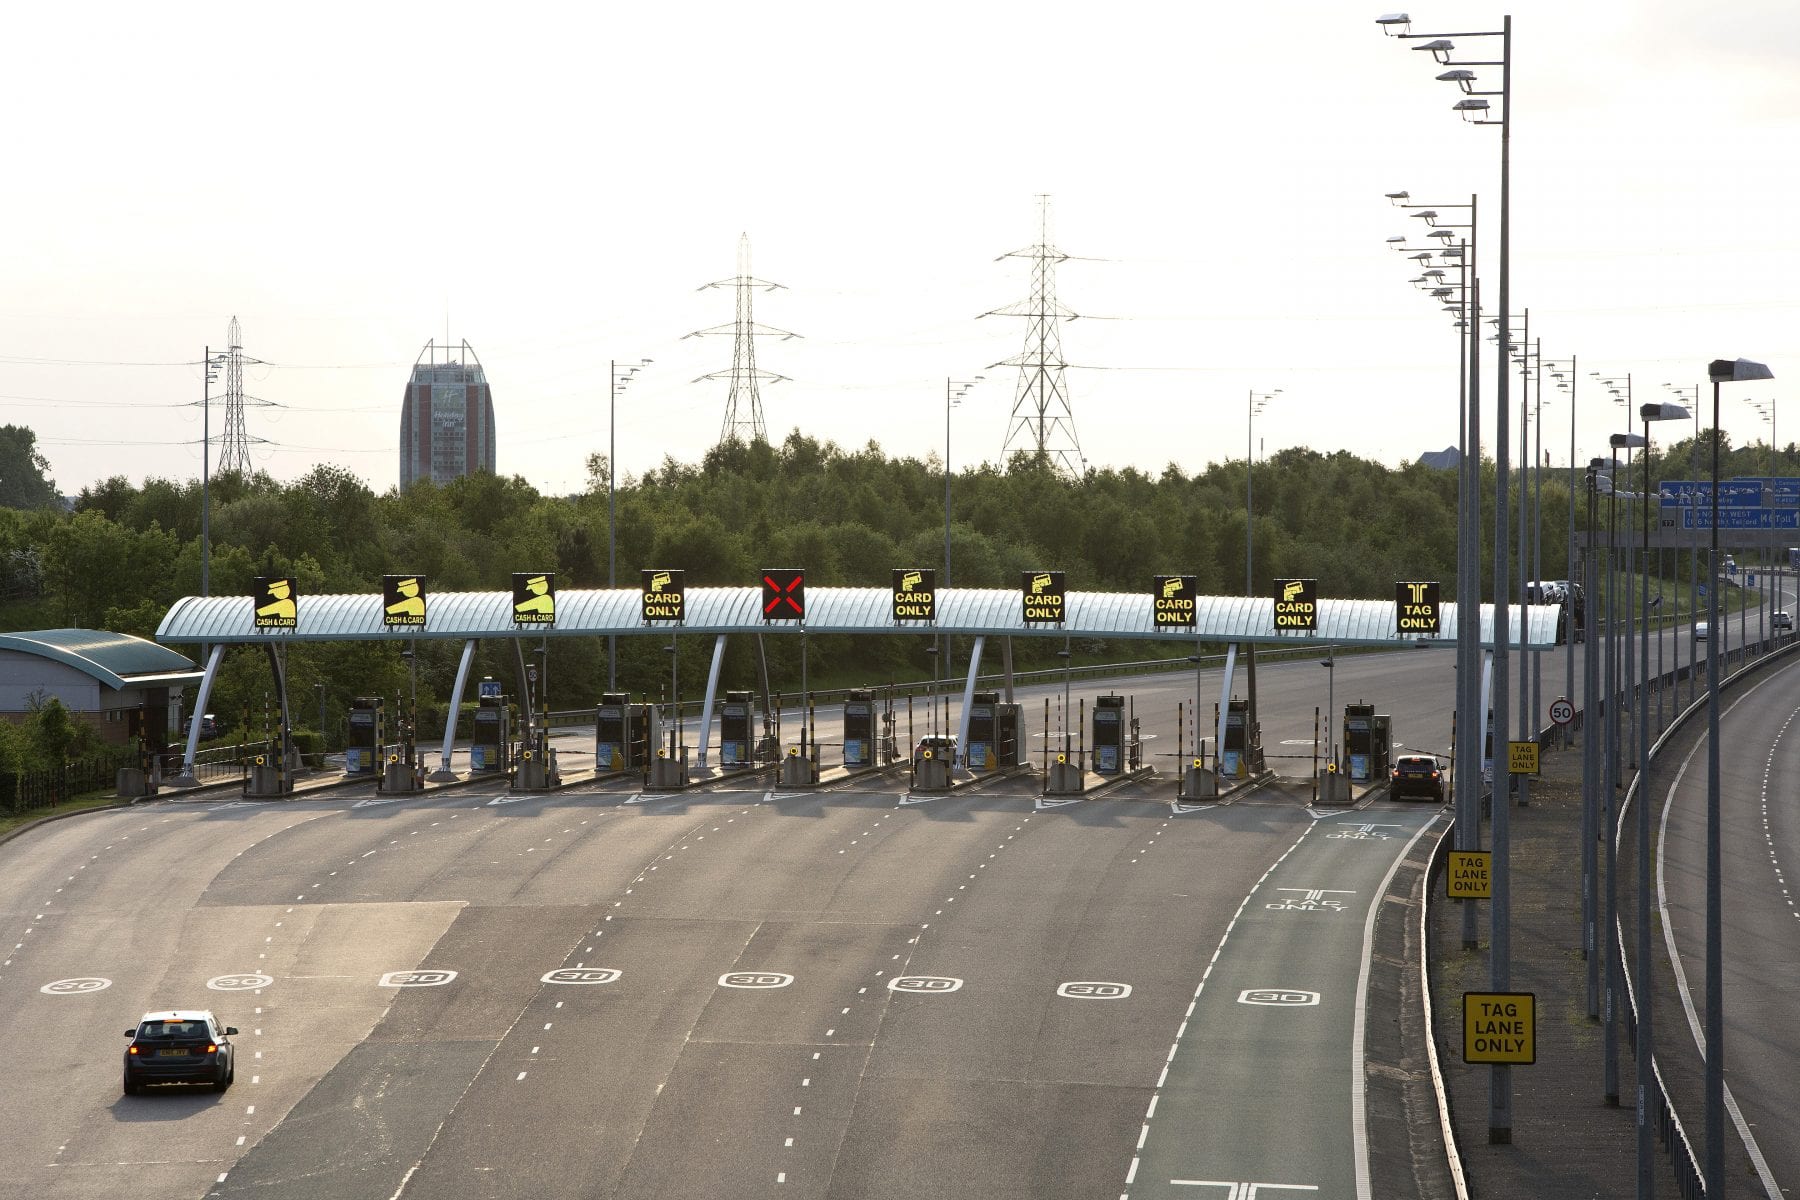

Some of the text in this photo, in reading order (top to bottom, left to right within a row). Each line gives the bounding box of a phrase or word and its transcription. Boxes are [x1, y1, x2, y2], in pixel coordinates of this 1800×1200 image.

[1775, 514, 1792, 523] Toll
[644, 593, 682, 604] CARD
[895, 592, 932, 603] CARD
[1025, 595, 1062, 606] CARD
[1155, 599, 1193, 609] CARD
[1276, 602, 1313, 613] CARD
[646, 606, 681, 616] ONLY
[895, 605, 931, 615] ONLY
[1026, 608, 1061, 618] ONLY
[1404, 605, 1432, 615] TAG
[256, 618, 272, 626] CASH
[278, 618, 295, 626] CARD
[386, 616, 402, 624] CASH
[408, 616, 425, 624] CARD
[515, 614, 531, 622] CASH
[537, 614, 554, 622] CARD
[1156, 612, 1192, 622] ONLY
[1277, 615, 1312, 625] ONLY
[1401, 618, 1436, 628] ONLY
[1553, 707, 1571, 719] 50
[1515, 745, 1532, 753] TAG
[1512, 753, 1535, 761] LANE
[1512, 761, 1535, 769] ONLY
[1458, 858, 1484, 868] TAG
[1454, 870, 1488, 880] LANE
[1454, 881, 1488, 892] ONLY
[1281, 898, 1342, 906] TAG
[1265, 903, 1350, 912] ONLY
[552, 972, 608, 980] 30
[731, 975, 781, 984] 30
[217, 978, 260, 986] 30
[901, 980, 951, 989] 30
[1068, 985, 1119, 995] 30
[1250, 993, 1308, 1002] 30
[1481, 1003, 1517, 1017] TAG
[1475, 1021, 1524, 1035] LANE
[1474, 1038, 1525, 1053] ONLY
